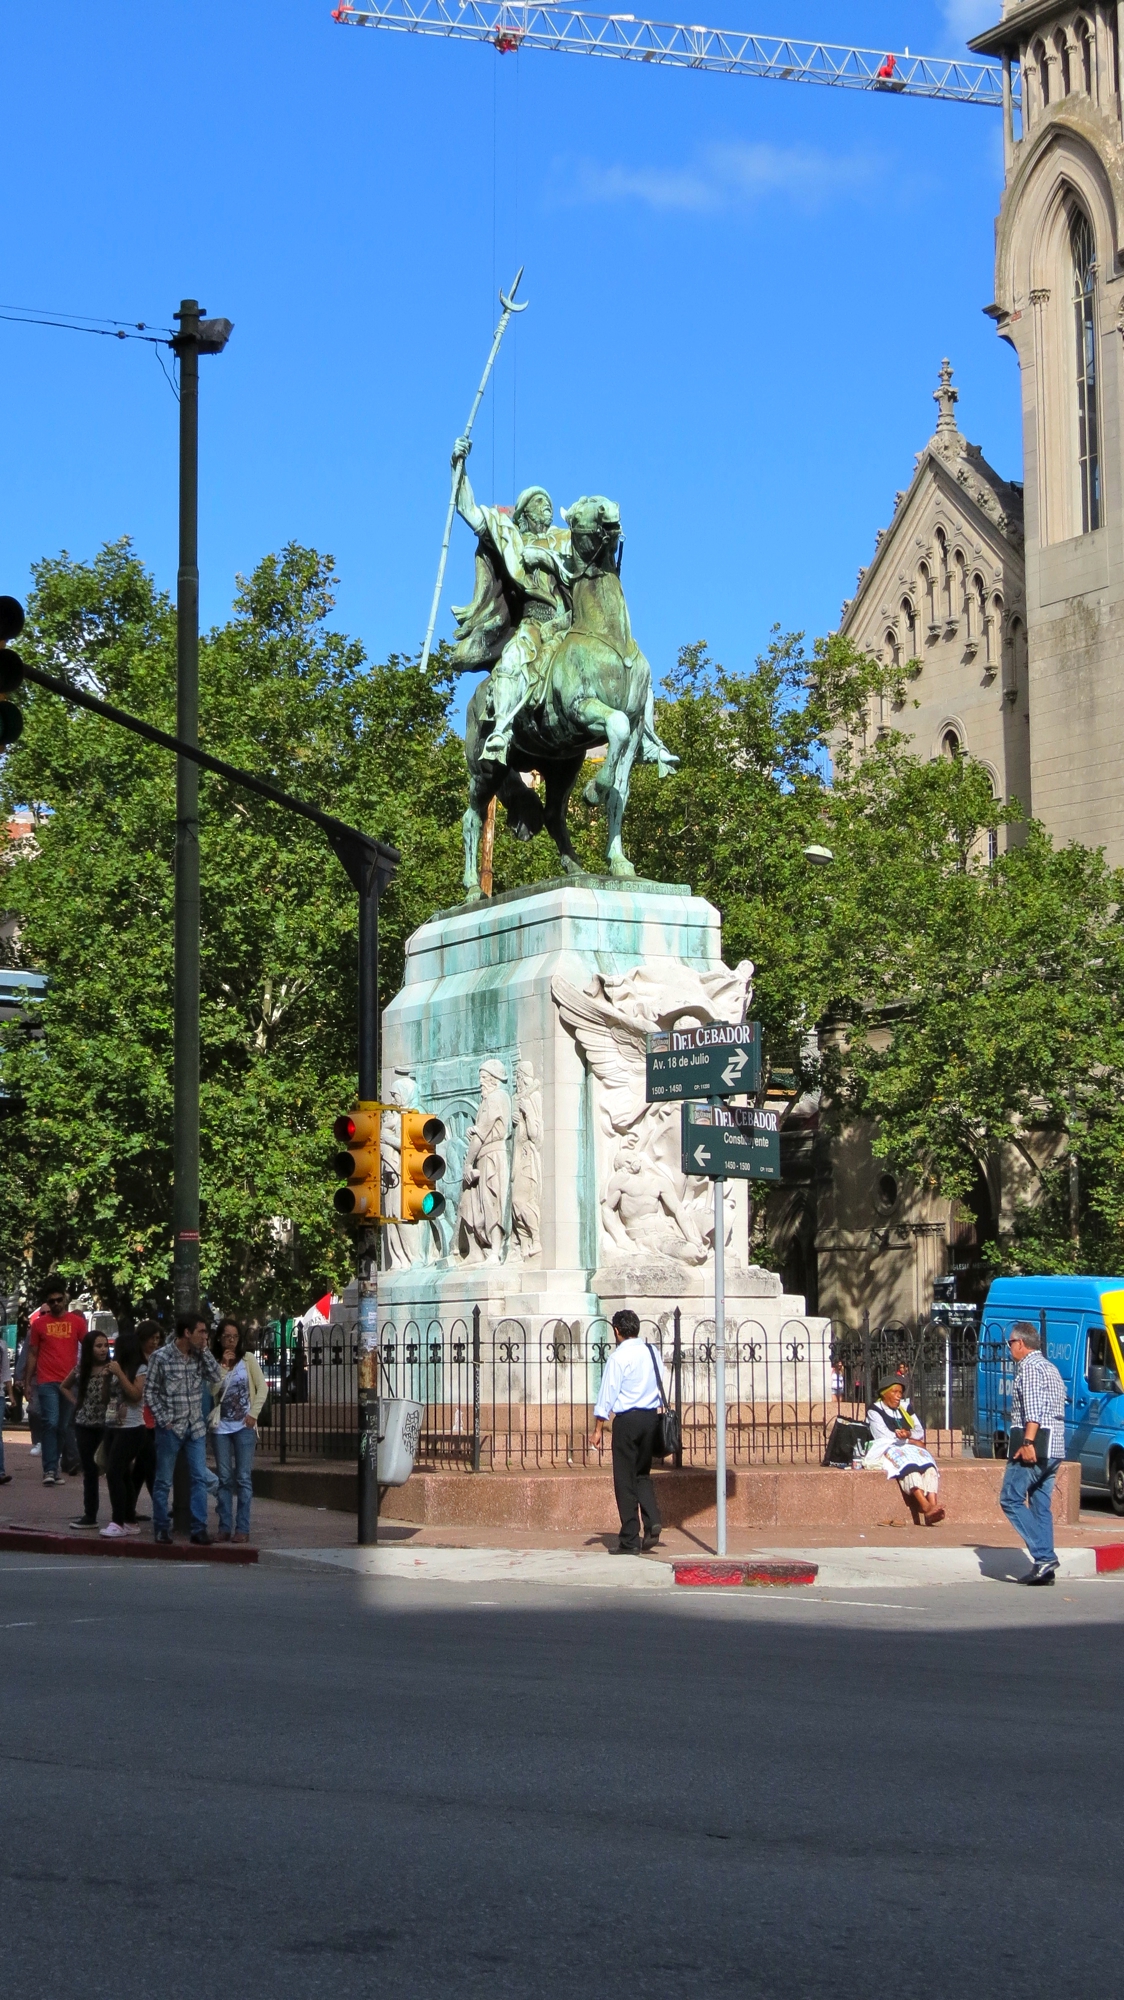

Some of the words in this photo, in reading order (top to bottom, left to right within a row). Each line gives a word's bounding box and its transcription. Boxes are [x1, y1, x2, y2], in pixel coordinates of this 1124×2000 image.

[673, 1032, 694, 1051] DEL
[696, 1025, 750, 1046] CEBADOR
[652, 1058, 666, 1071] Av.
[667, 1056, 677, 1069] 18
[678, 1055, 689, 1067] de
[690, 1052, 710, 1066] Julio
[651, 1086, 665, 1095] 1500
[669, 1084, 683, 1093] 1450
[714, 1108, 735, 1128] DEL
[735, 1109, 777, 1131] CEBADOR
[724, 1132, 769, 1149] Constituyente
[724, 1160, 736, 1170] 1450
[739, 1161, 751, 1171] 1500
